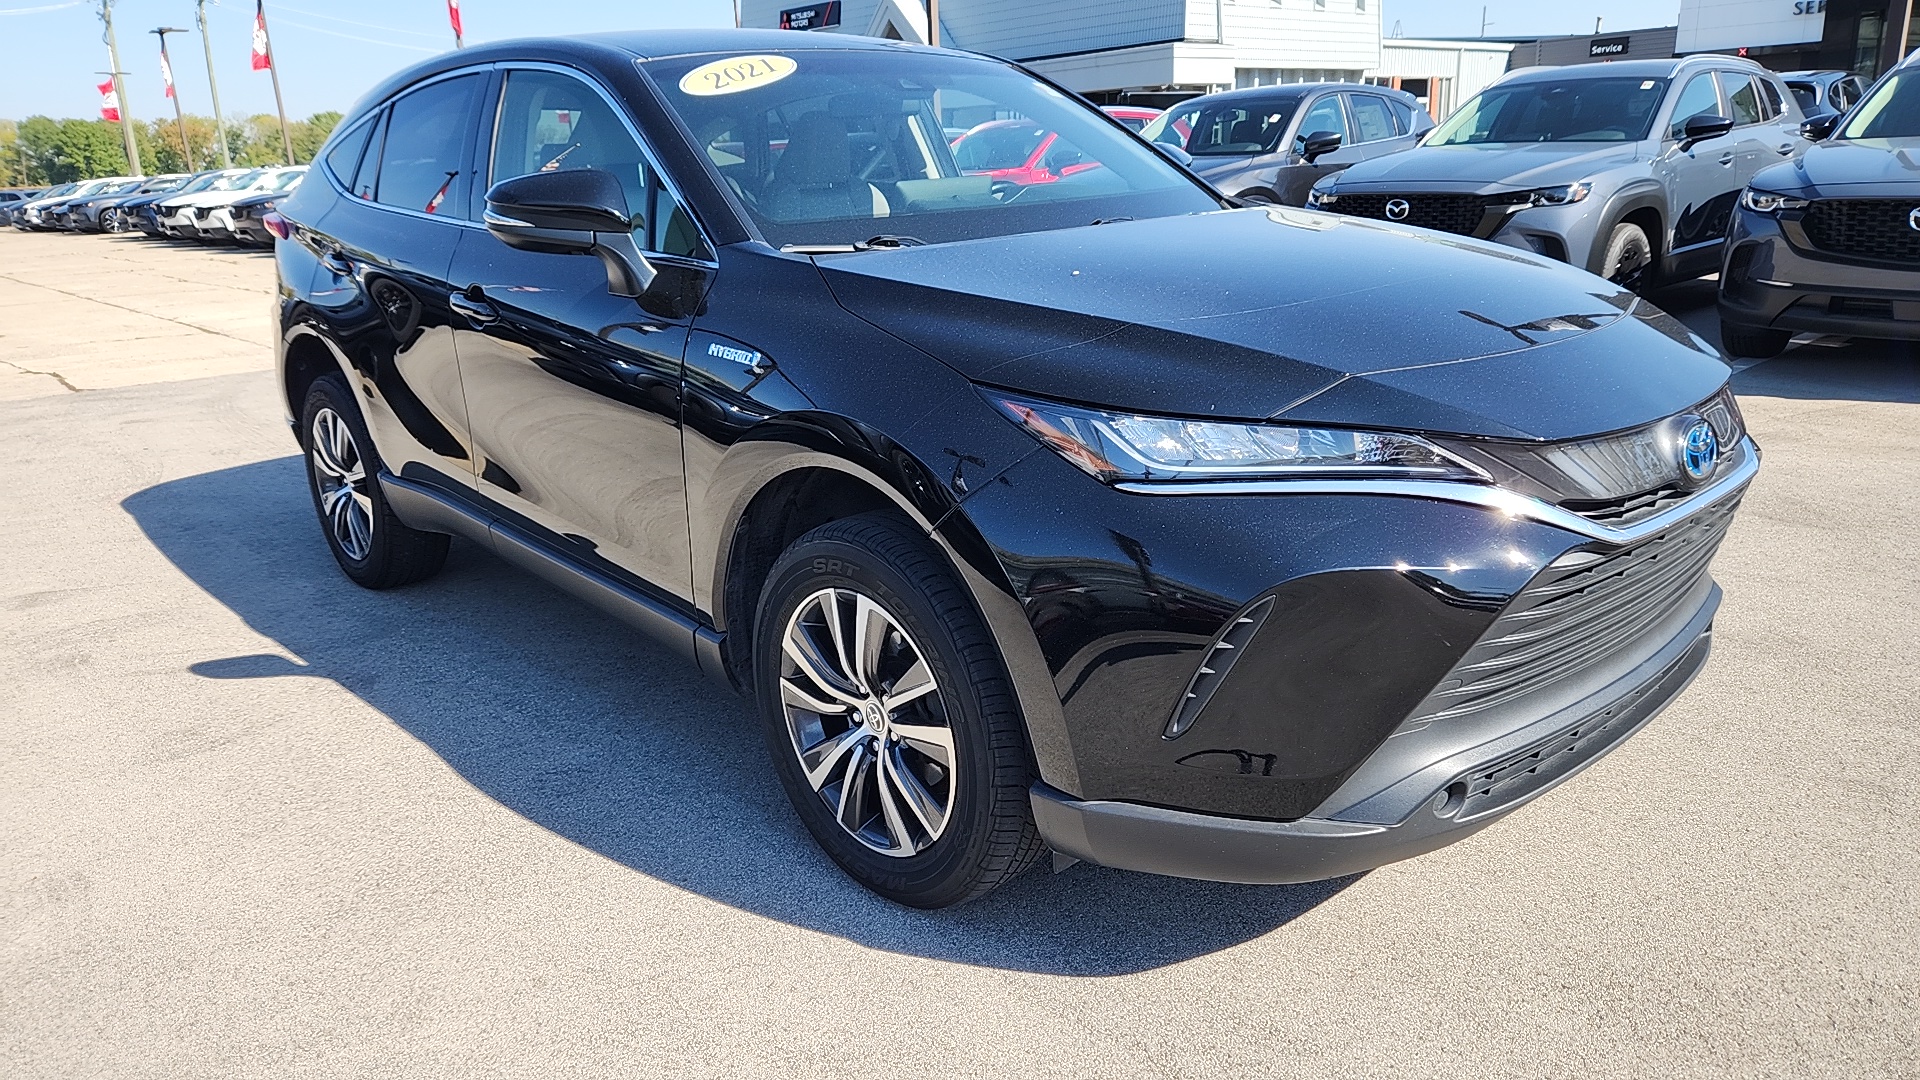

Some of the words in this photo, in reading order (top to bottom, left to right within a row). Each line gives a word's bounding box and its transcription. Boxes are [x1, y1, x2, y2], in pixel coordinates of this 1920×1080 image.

[1591, 44, 1623, 54] Service
[704, 59, 777, 89] 2021
[708, 343, 753, 366] HYBRID
[811, 558, 860, 578] SRT
